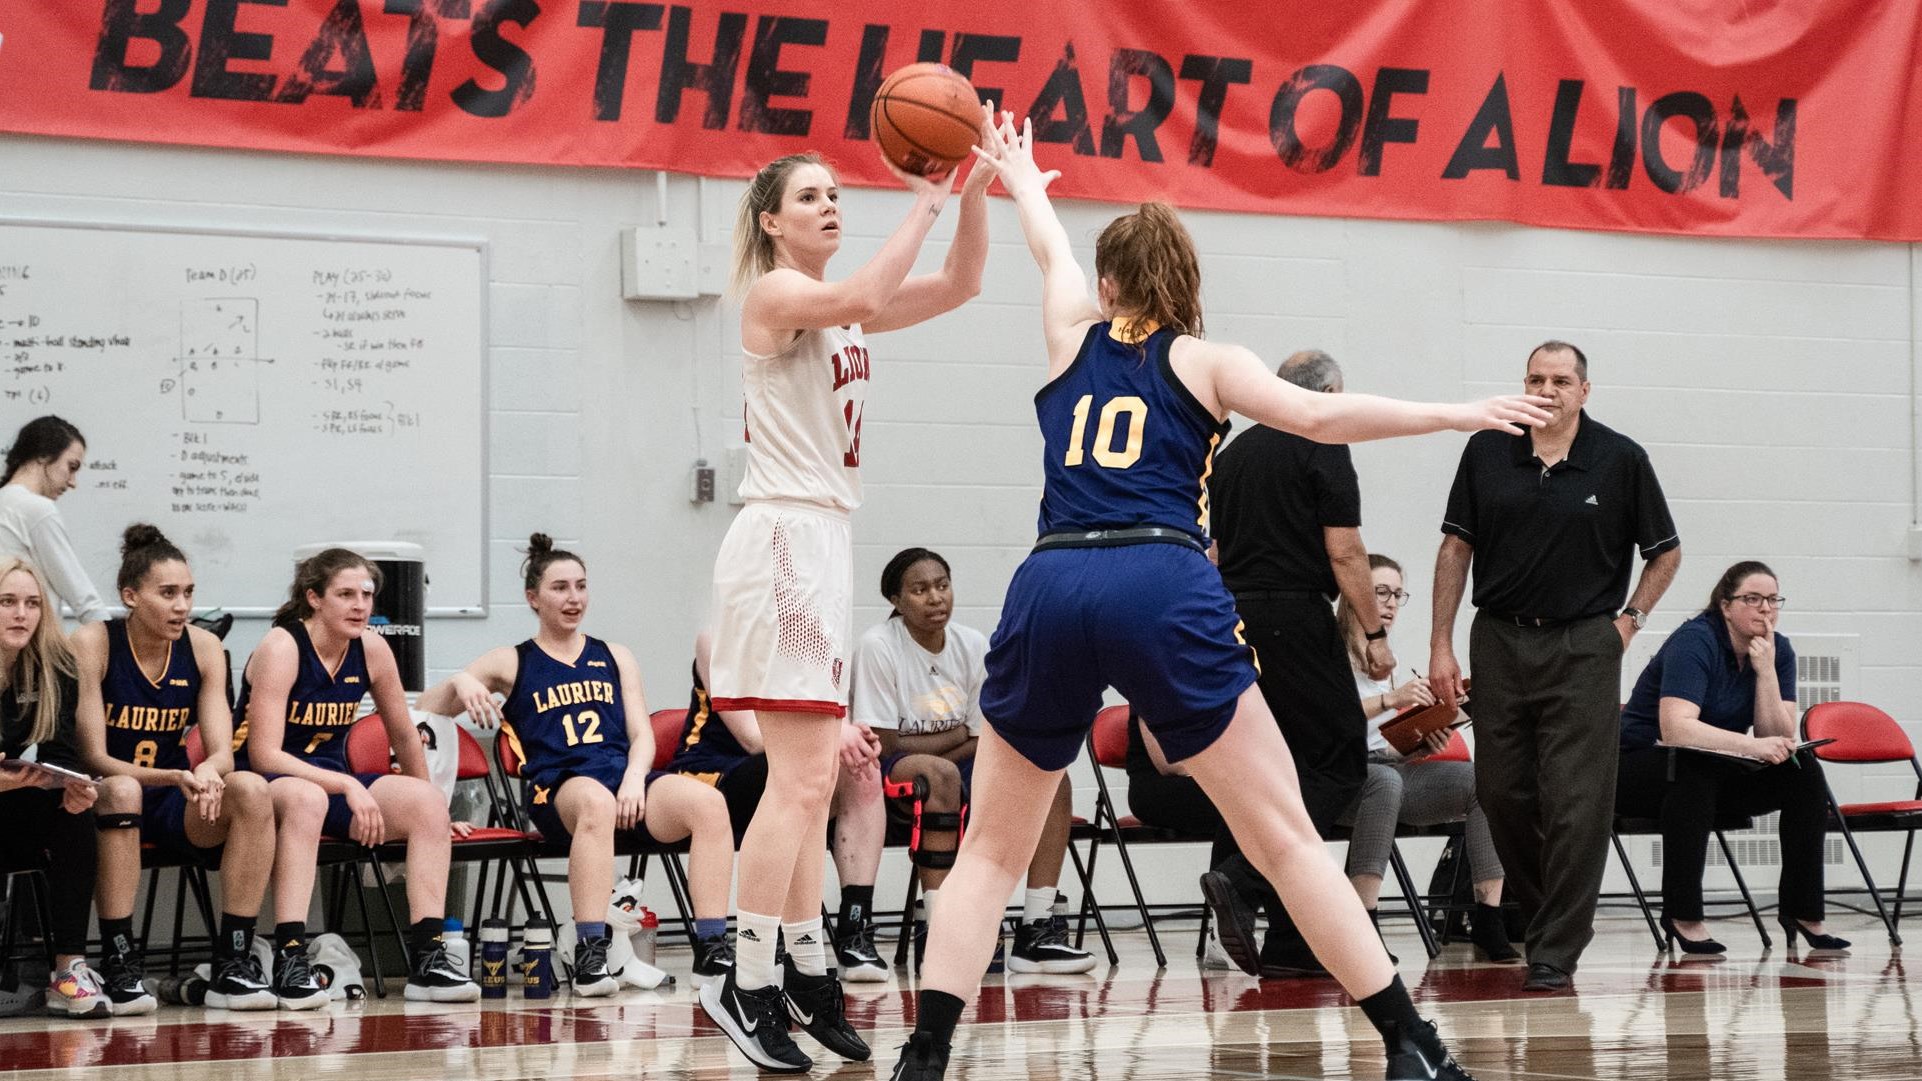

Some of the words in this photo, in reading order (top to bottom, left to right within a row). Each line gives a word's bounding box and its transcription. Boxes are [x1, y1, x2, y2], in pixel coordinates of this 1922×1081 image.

[89, 0, 538, 117] BEATS
[577, 0, 827, 137] THE
[1269, 63, 1431, 176] OF
[1440, 69, 1521, 182] A
[1540, 79, 1798, 202] LION
[1064, 394, 1148, 469] 10
[366, 624, 421, 637] WERADE
[532, 680, 614, 714] LAURIER
[105, 703, 190, 732] LAURIER
[562, 710, 604, 747] 12
[133, 740, 158, 769] 8
